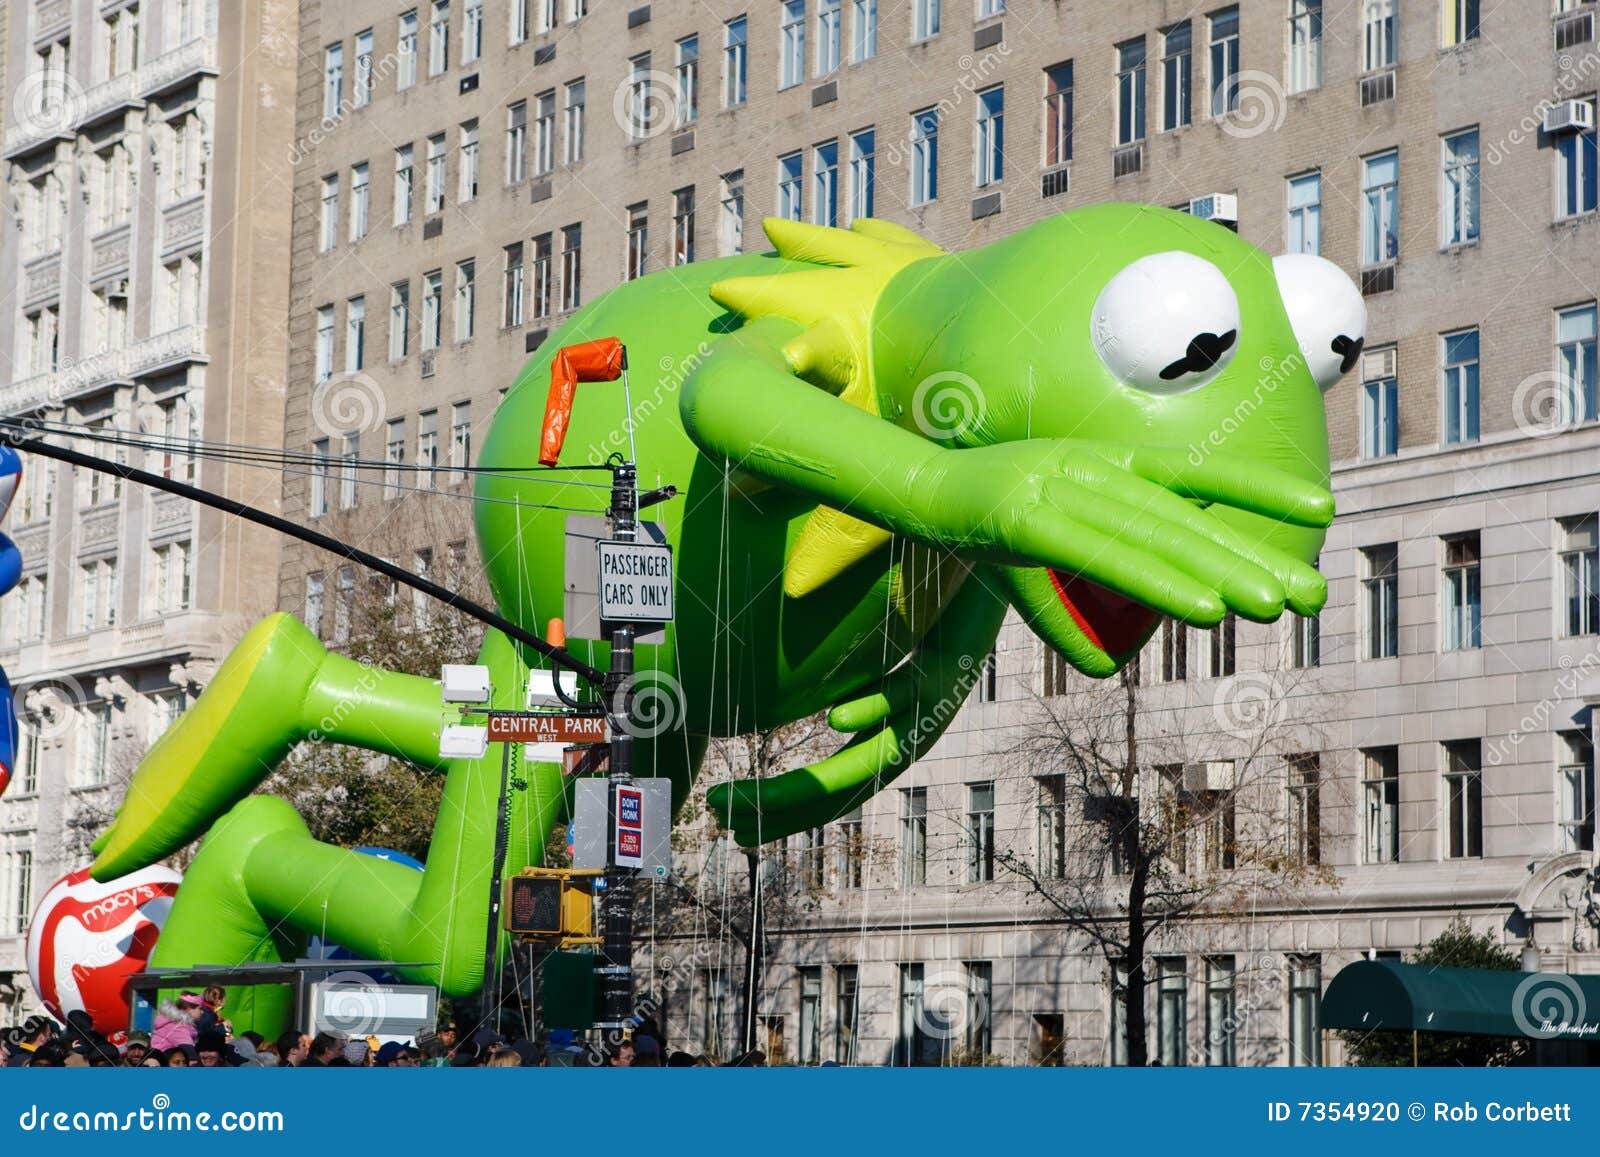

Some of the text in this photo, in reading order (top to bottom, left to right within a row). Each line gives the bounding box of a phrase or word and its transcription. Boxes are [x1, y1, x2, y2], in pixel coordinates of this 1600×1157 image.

[604, 553, 668, 577] PASSENGER
[605, 583, 668, 606] CARS ONLY
[490, 716, 602, 734] CENTRAL PARK
[537, 733, 557, 742] WEST
[622, 797, 638, 809] DON'T
[622, 809, 638, 821] HONK
[1540, 1020, 1557, 1033] The
